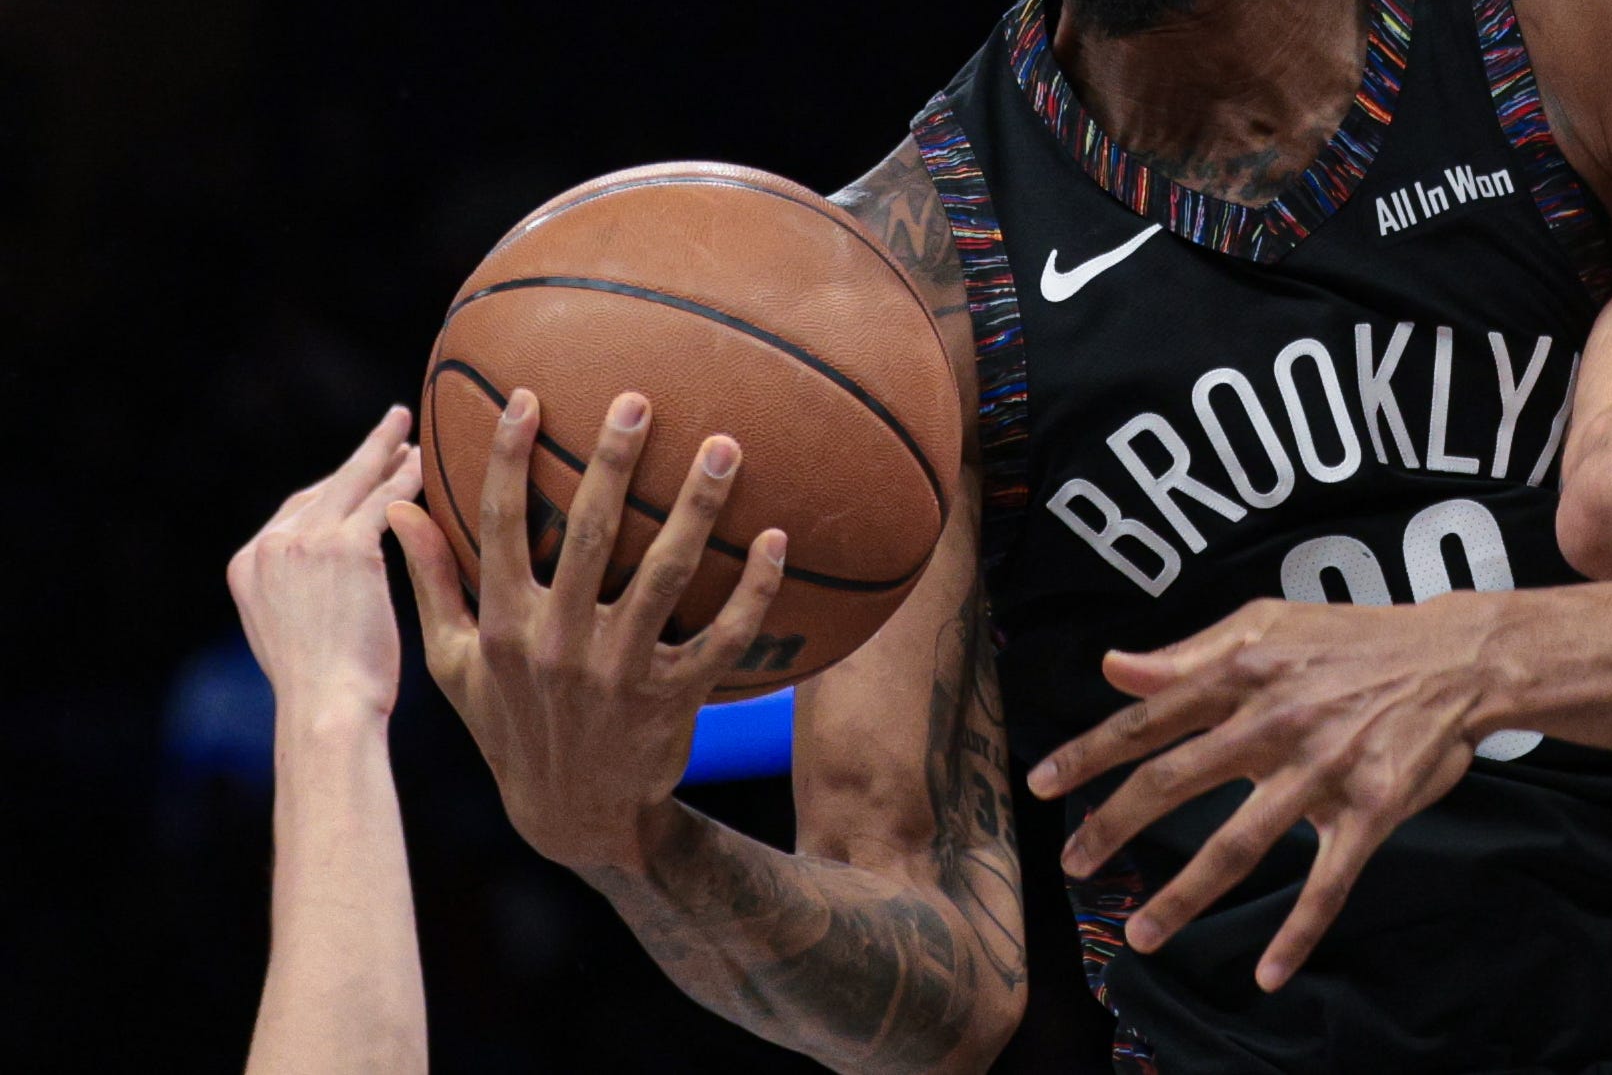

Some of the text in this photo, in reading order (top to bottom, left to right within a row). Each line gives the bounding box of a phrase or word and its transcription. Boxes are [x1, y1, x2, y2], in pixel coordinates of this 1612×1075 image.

[1375, 164, 1515, 237] All In Won
[1046, 321, 1580, 598] BROOKLY
